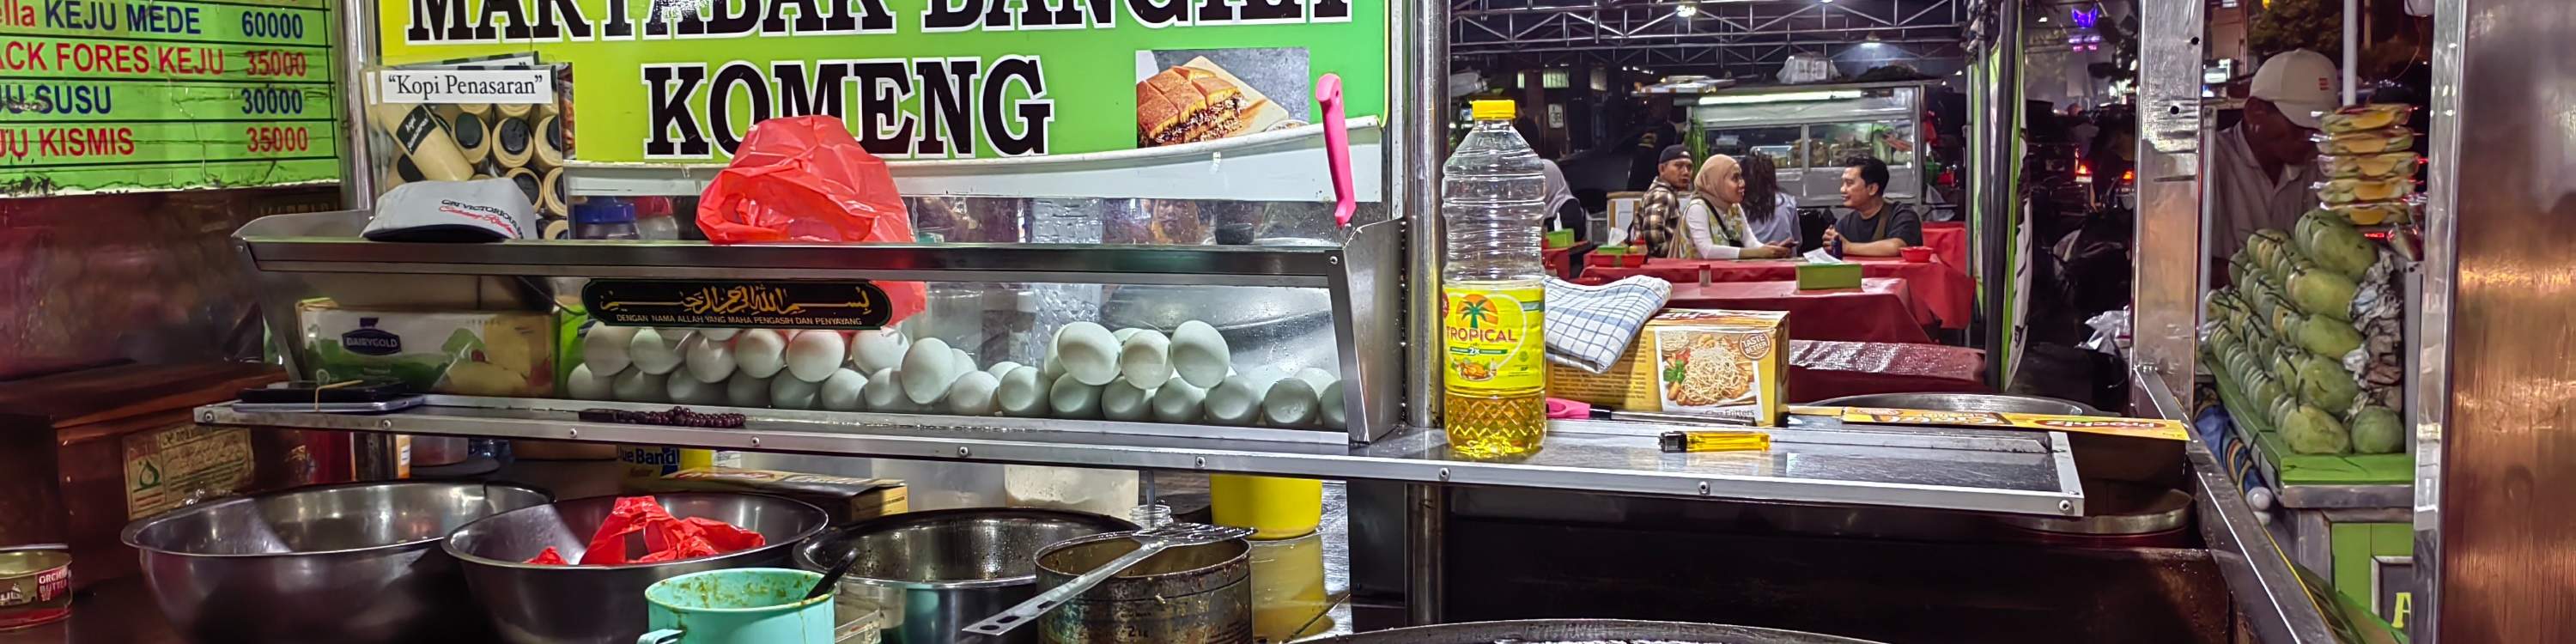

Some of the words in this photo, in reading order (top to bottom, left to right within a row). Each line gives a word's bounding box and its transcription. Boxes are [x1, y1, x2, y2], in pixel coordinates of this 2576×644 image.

[0, 0, 35, 27] lla
[46, 0, 117, 30] KEJU
[126, 3, 202, 34] MEDE
[241, 11, 303, 39] 60000
[0, 41, 48, 70] CK
[56, 43, 149, 73] FORES
[158, 46, 224, 75] KEJU
[246, 51, 307, 76] 35000
[35, 84, 112, 114] SUSU
[240, 88, 303, 114] 30000
[641, 55, 1054, 160] KOMENG
[39, 127, 135, 156] KISMIS
[246, 127, 308, 152] 35000
[652, 314, 675, 323] NAMA
[346, 337, 398, 348] DAIRYGOLD
[1446, 326, 1518, 343] TROPICAL
[1743, 335, 1765, 347] TASTE
[1745, 342, 1768, 354] BETTER
[635, 447, 677, 465] Band
